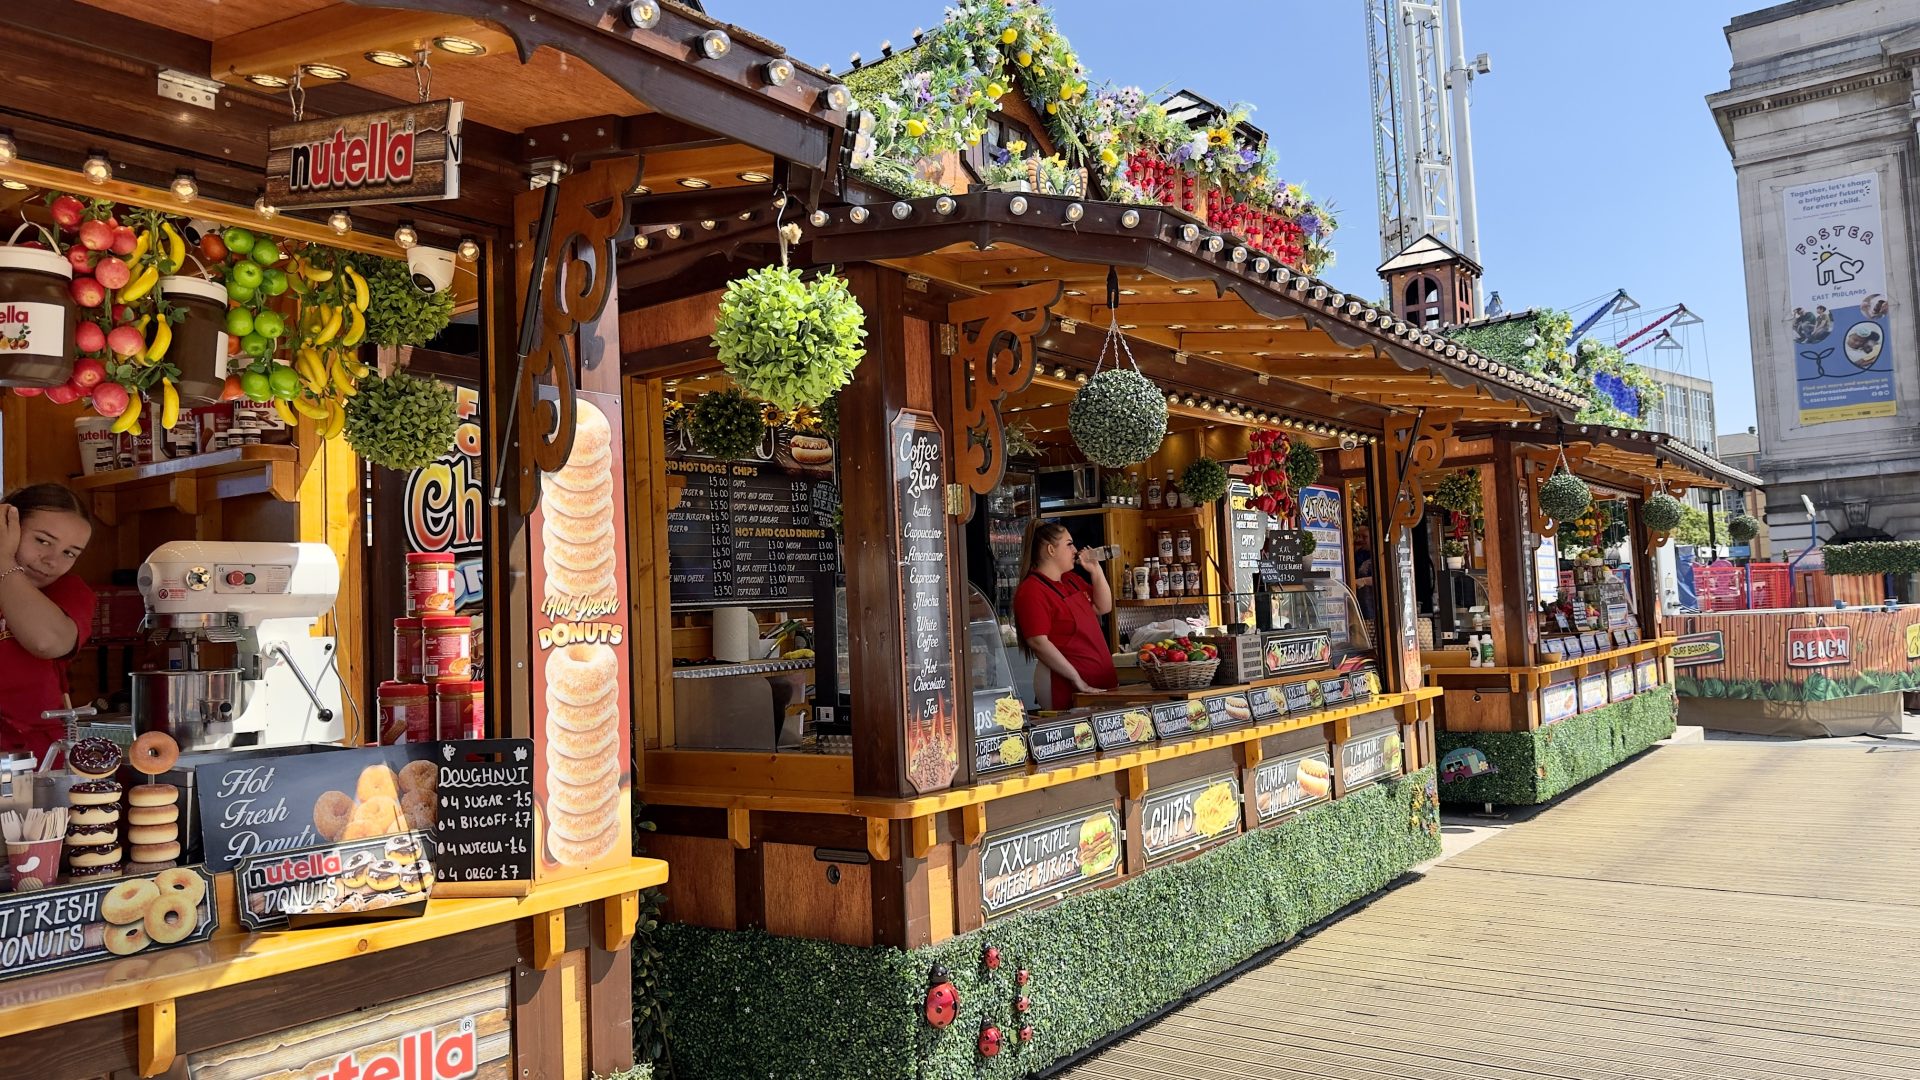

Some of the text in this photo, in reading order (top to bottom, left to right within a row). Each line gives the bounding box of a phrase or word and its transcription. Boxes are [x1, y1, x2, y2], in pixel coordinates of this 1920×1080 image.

[290, 121, 415, 189] nutella
[1790, 179, 1872, 198] Together, let's shape
[1805, 194, 1837, 203] brighter
[1838, 188, 1865, 197] future
[1816, 201, 1838, 210] every
[1839, 196, 1861, 205] child.
[1795, 225, 1873, 255] FOSTER
[1812, 288, 1867, 301] EAST MIDLANDS
[900, 432, 939, 469] Coffee
[679, 462, 699, 473] HOT
[700, 463, 727, 474] DOGS
[733, 466, 758, 477] CHIPS
[913, 501, 931, 518] Latte
[735, 528, 825, 538] HOT AND COLD DRINKS
[904, 522, 942, 541] Cappuccino
[905, 545, 944, 565] Americano
[909, 567, 940, 587] Espresso
[540, 592, 620, 622] Hot Fresh
[913, 592, 939, 610] Mocha
[917, 616, 937, 631] White
[538, 622, 623, 650] DONUTS
[917, 632, 939, 652] Coffee
[1280, 643, 1299, 664] FRESH
[1672, 642, 1710, 656] SURF BOARDS
[1792, 639, 1847, 660] BEACH
[921, 658, 938, 677] Hot
[914, 676, 945, 692] Chocolate
[924, 698, 939, 717] Tea
[217, 765, 275, 799] Hot
[440, 766, 529, 785] DOUGHNUT
[1260, 760, 1287, 793] JUMBO
[451, 795, 459, 810] 4
[464, 794, 503, 808] SUGAR
[1269, 780, 1300, 815] HOT DOG
[220, 797, 289, 829] Fresh
[447, 818, 456, 829] 4
[460, 813, 506, 829] BISCOFF
[1150, 793, 1193, 847] CHIPS
[223, 824, 317, 861] Donuts
[447, 842, 457, 856] 4
[459, 840, 503, 856] NUTELLA
[999, 824, 1071, 876] XXL TRIPLE
[249, 851, 342, 888] nutella
[449, 867, 458, 881] 4
[992, 848, 1080, 908] CHEESE BURGER
[264, 877, 337, 914] DONUTS
[17, 892, 99, 938] FRESH
